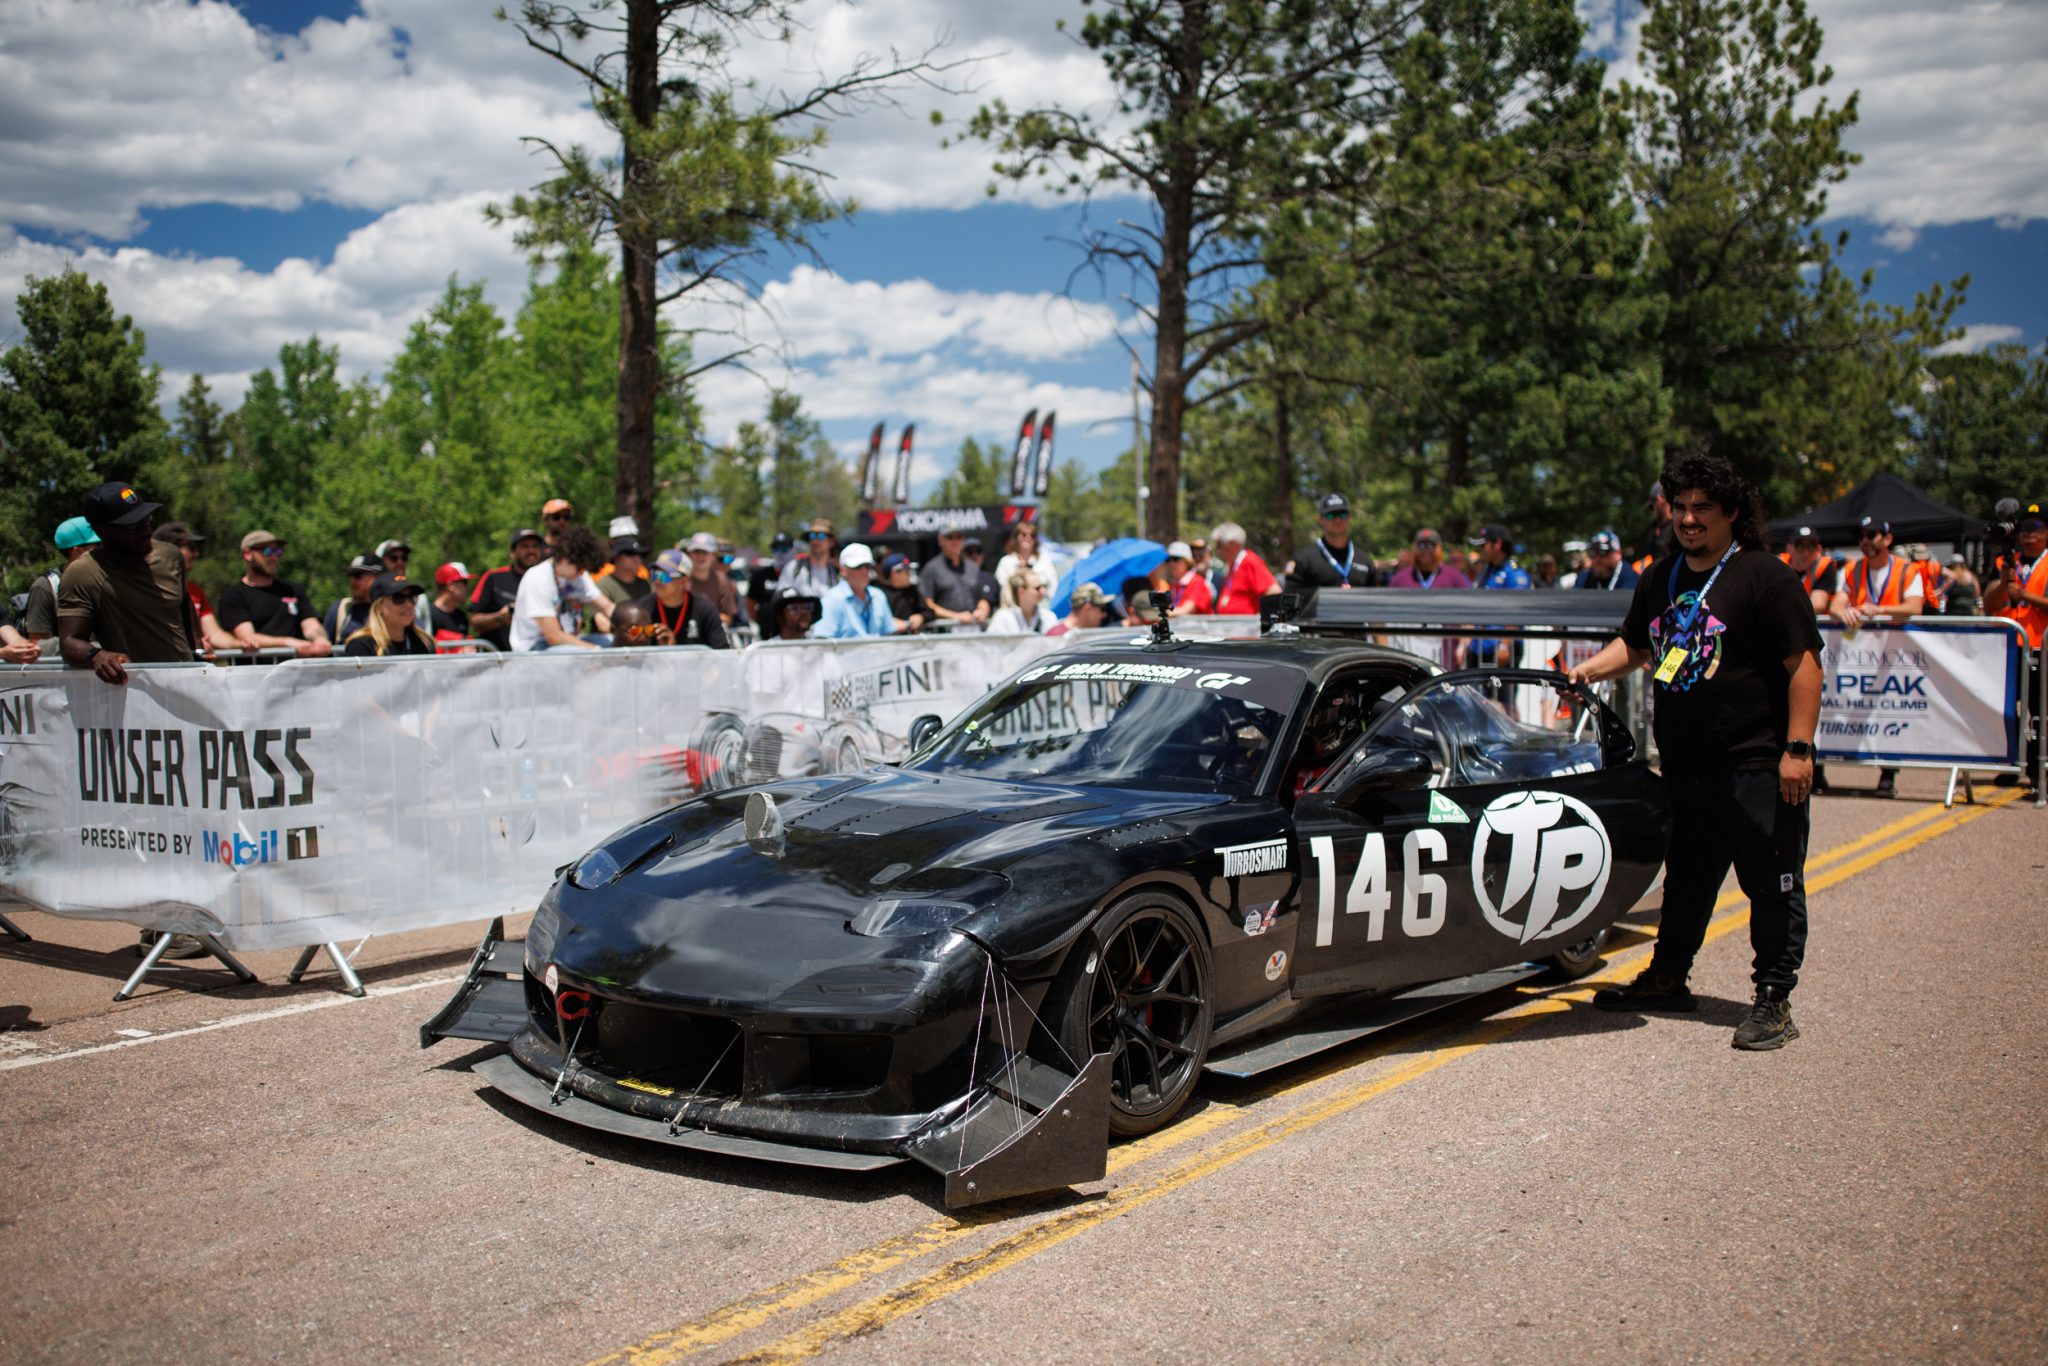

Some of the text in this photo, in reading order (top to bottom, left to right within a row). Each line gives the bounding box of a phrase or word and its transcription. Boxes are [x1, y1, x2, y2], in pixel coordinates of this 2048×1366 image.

[1821, 648, 1928, 668] ROADMOOR
[1060, 663, 1115, 675] GRAN
[1108, 663, 1194, 680] TURISMO
[1125, 675, 1177, 685] SIMULATOR
[1836, 675, 1926, 696] PEAK
[1847, 699, 1877, 710] HILL
[1881, 699, 1928, 712] CLIMB
[1820, 721, 1879, 737] TURISMO
[77, 727, 314, 810] UNSER PASS
[81, 827, 168, 853] PRESENTED
[173, 834, 193, 855] BY
[202, 829, 279, 866] Mobil
[1214, 838, 1288, 878] TURBOSMART
[1310, 828, 1449, 948] 146
